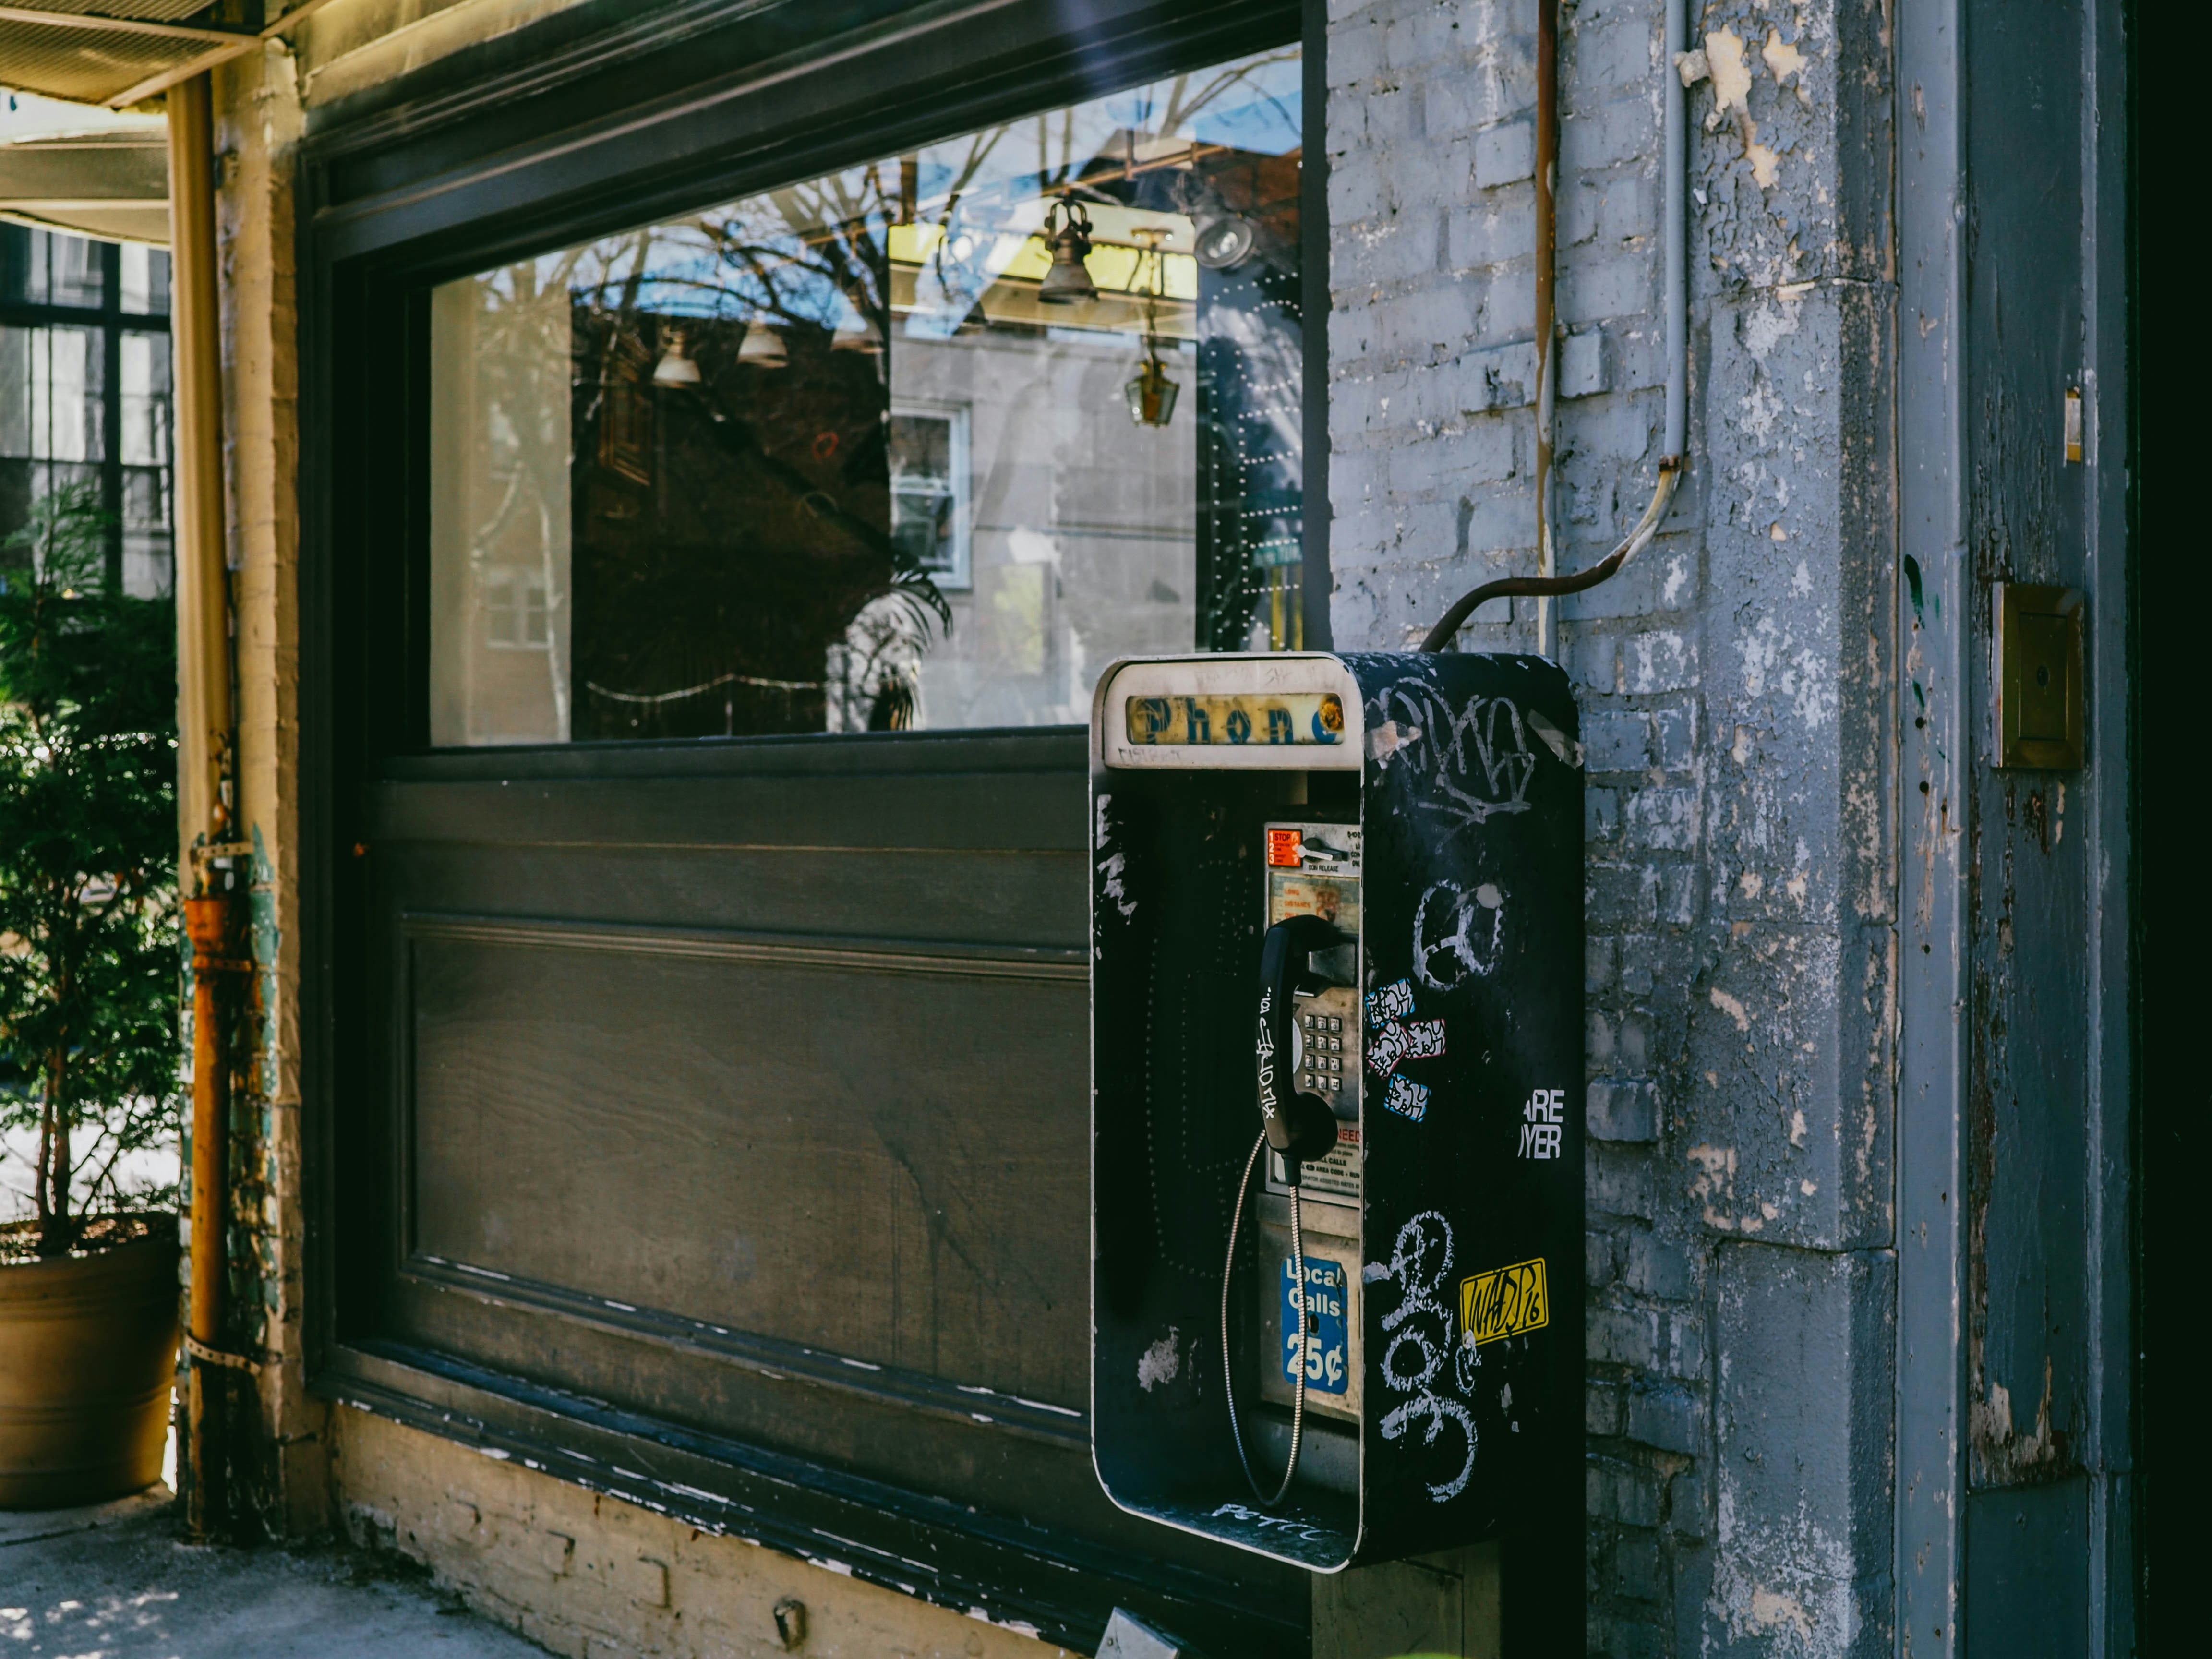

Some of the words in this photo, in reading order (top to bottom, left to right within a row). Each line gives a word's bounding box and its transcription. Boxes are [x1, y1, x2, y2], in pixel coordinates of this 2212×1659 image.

[1269, 831, 1274, 842] 1
[1274, 833, 1291, 841] STOP
[1269, 842, 1274, 853] 2
[1269, 854, 1274, 865] 3
[1518, 1123, 1562, 1159] YER
[1328, 1157, 1347, 1166] CALLS
[1330, 1168, 1344, 1176] CODE
[1288, 1287, 1340, 1317] Calls
[1287, 1333, 1342, 1387] 25¢
